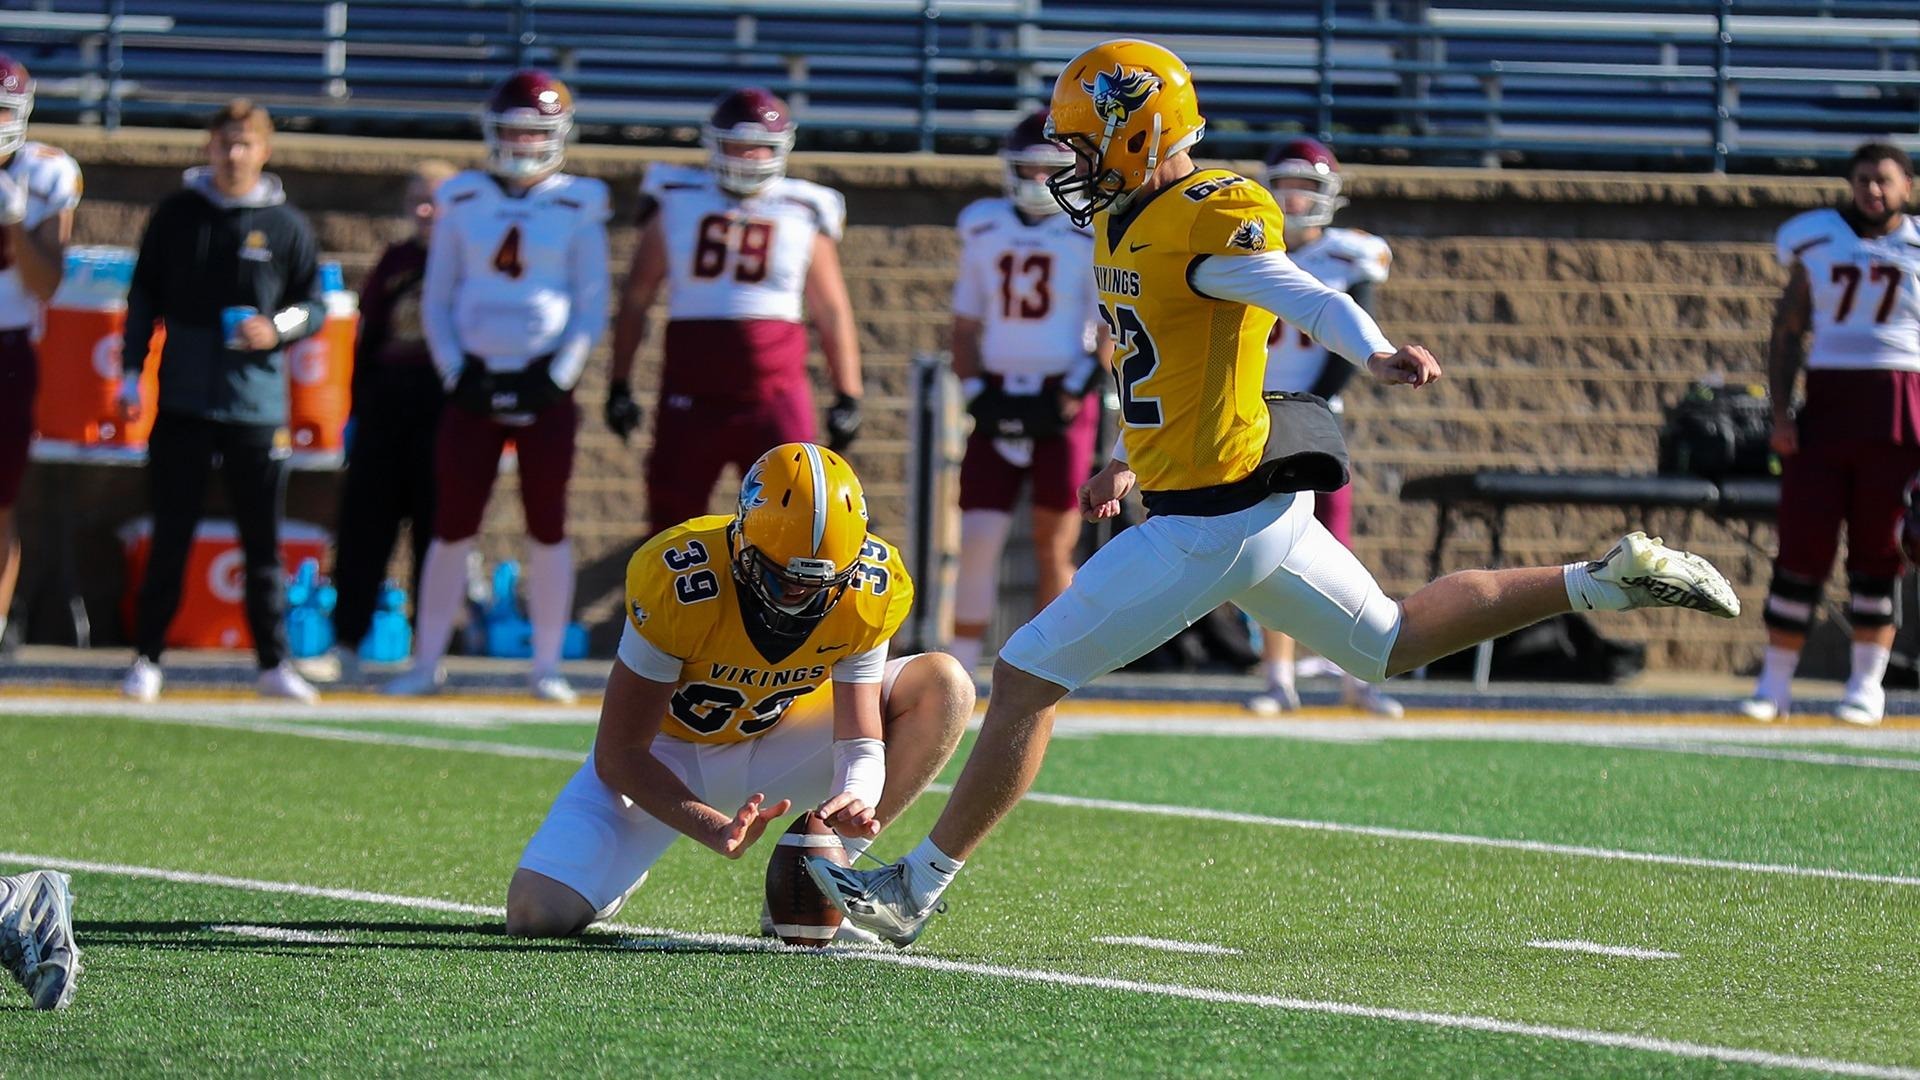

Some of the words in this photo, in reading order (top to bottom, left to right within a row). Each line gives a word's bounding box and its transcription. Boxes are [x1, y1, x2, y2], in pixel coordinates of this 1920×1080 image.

[492, 225, 524, 280] 4
[692, 214, 775, 284] 69
[997, 251, 1052, 321] 13
[1829, 262, 1902, 326] 77
[662, 539, 720, 606] 39
[849, 537, 891, 596] 39
[709, 662, 826, 687] VIKINGS
